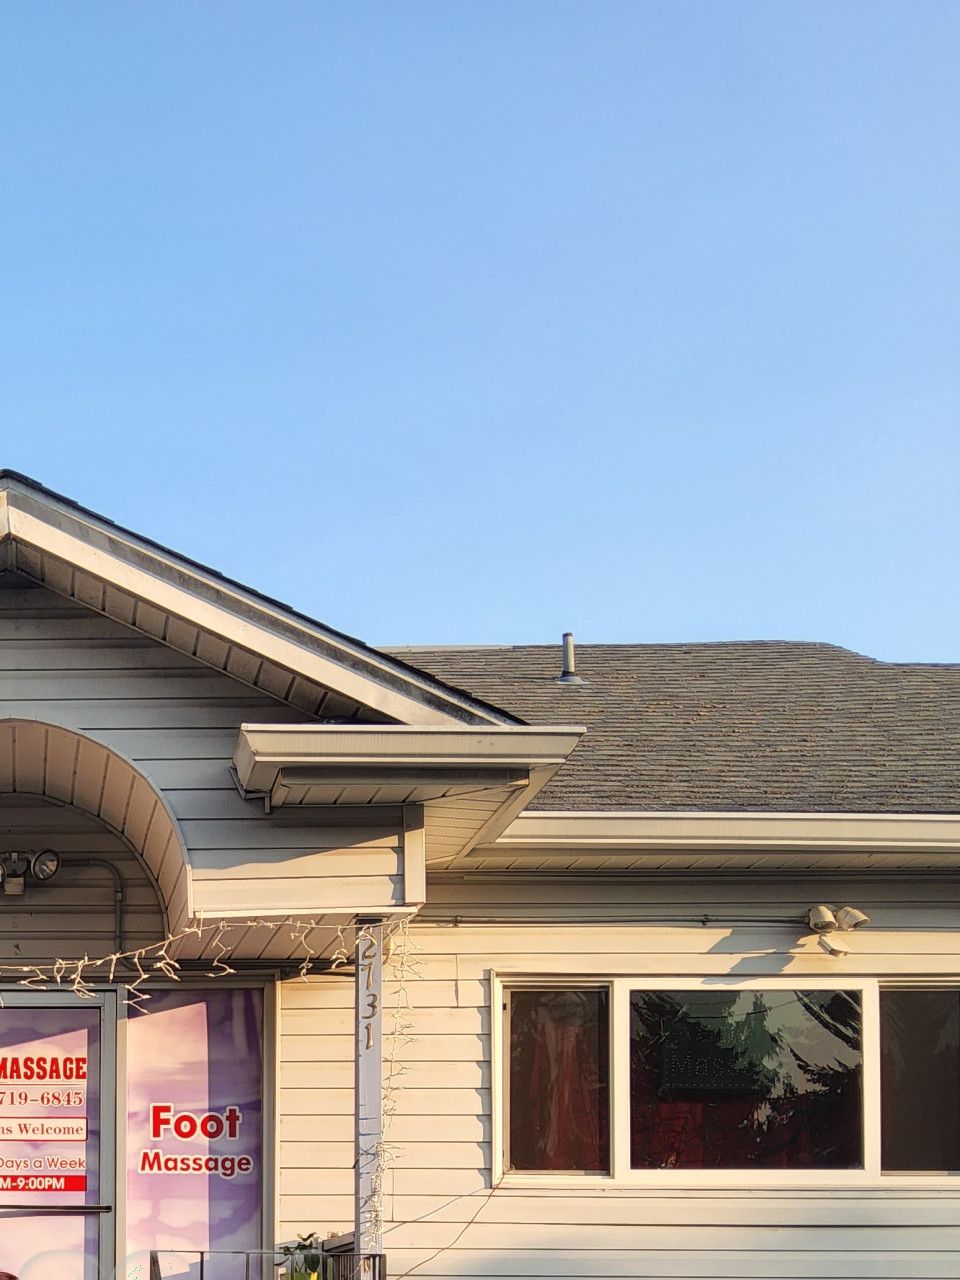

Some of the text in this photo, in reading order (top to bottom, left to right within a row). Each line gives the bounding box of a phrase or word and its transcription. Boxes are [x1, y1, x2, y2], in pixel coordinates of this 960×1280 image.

[18, 1123, 84, 1135] Welcome
[152, 1105, 240, 1138] Foot
[33, 1159, 43, 1168] a
[47, 1157, 85, 1168] Week
[141, 1152, 251, 1177] Massage
